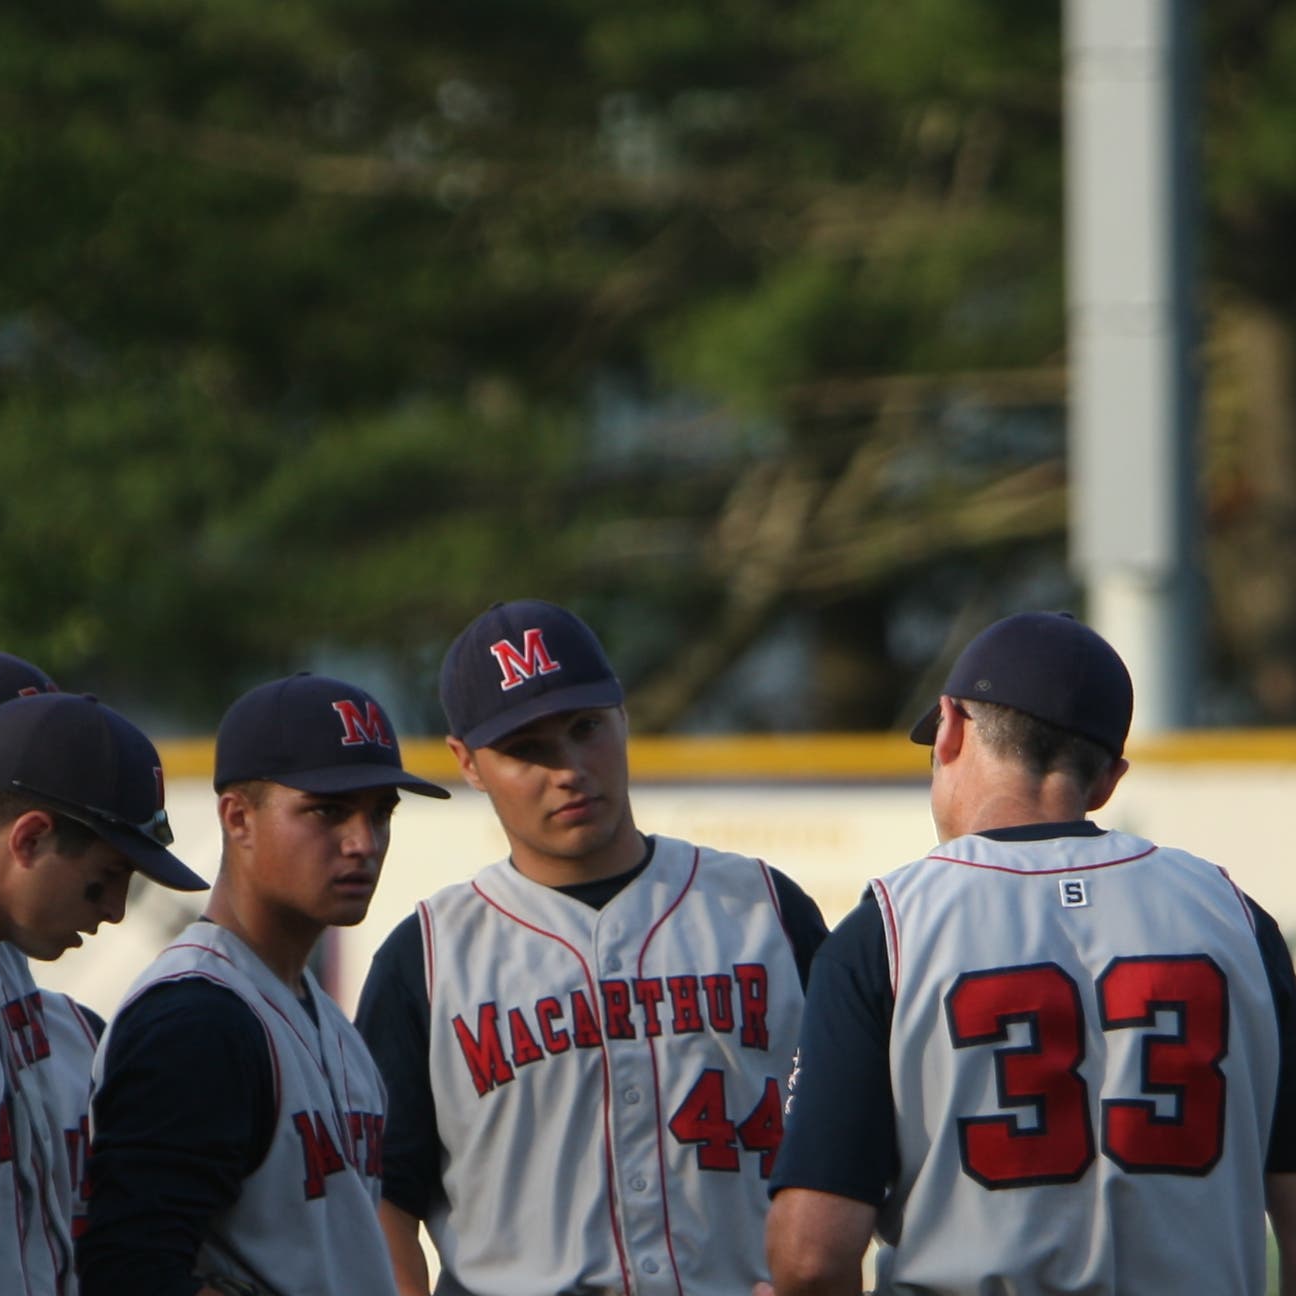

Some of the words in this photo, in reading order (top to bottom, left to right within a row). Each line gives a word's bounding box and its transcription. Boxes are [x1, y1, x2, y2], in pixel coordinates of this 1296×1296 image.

[490, 628, 561, 691] M
[331, 700, 392, 748] M
[453, 964, 769, 1098] MACARTHUR
[943, 953, 1229, 1191] 33
[668, 1068, 785, 1180] 44
